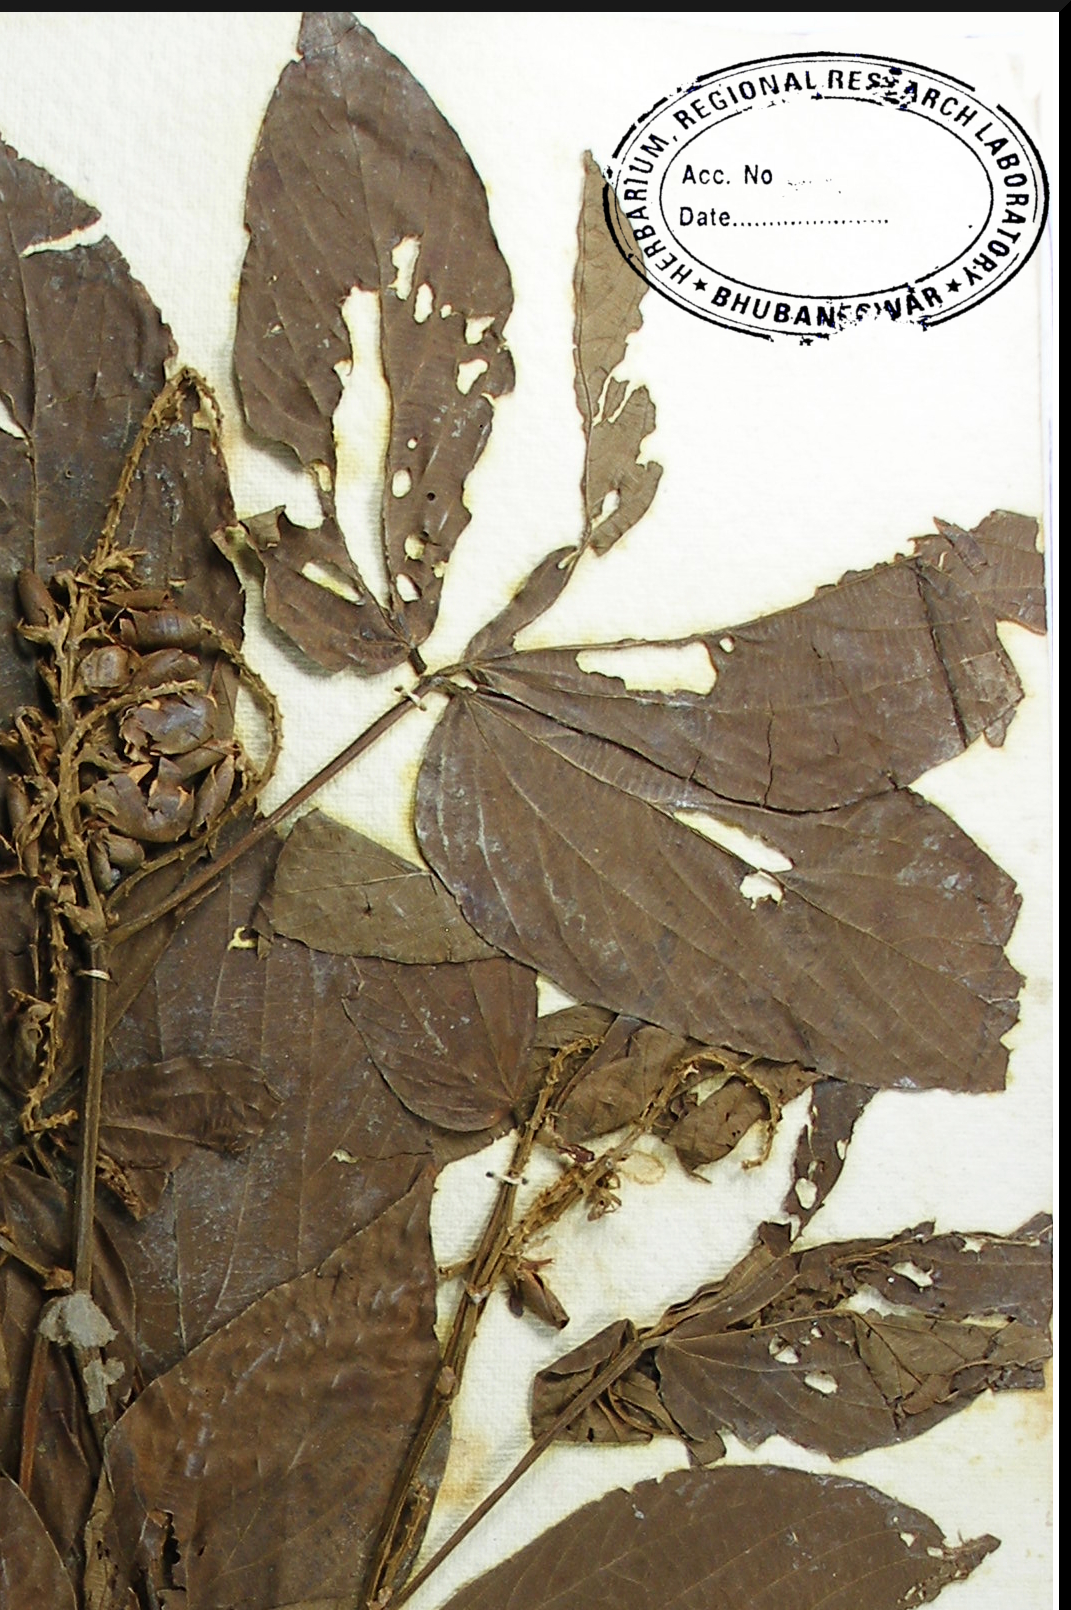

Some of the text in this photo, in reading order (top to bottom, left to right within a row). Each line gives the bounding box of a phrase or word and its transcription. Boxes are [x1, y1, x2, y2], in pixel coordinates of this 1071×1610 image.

[624, 133, 696, 286] HERBARIUM,
[674, 70, 817, 130] REGIONAL
[974, 121, 1029, 287] LABORATORY
[681, 163, 773, 185] Acc. No
